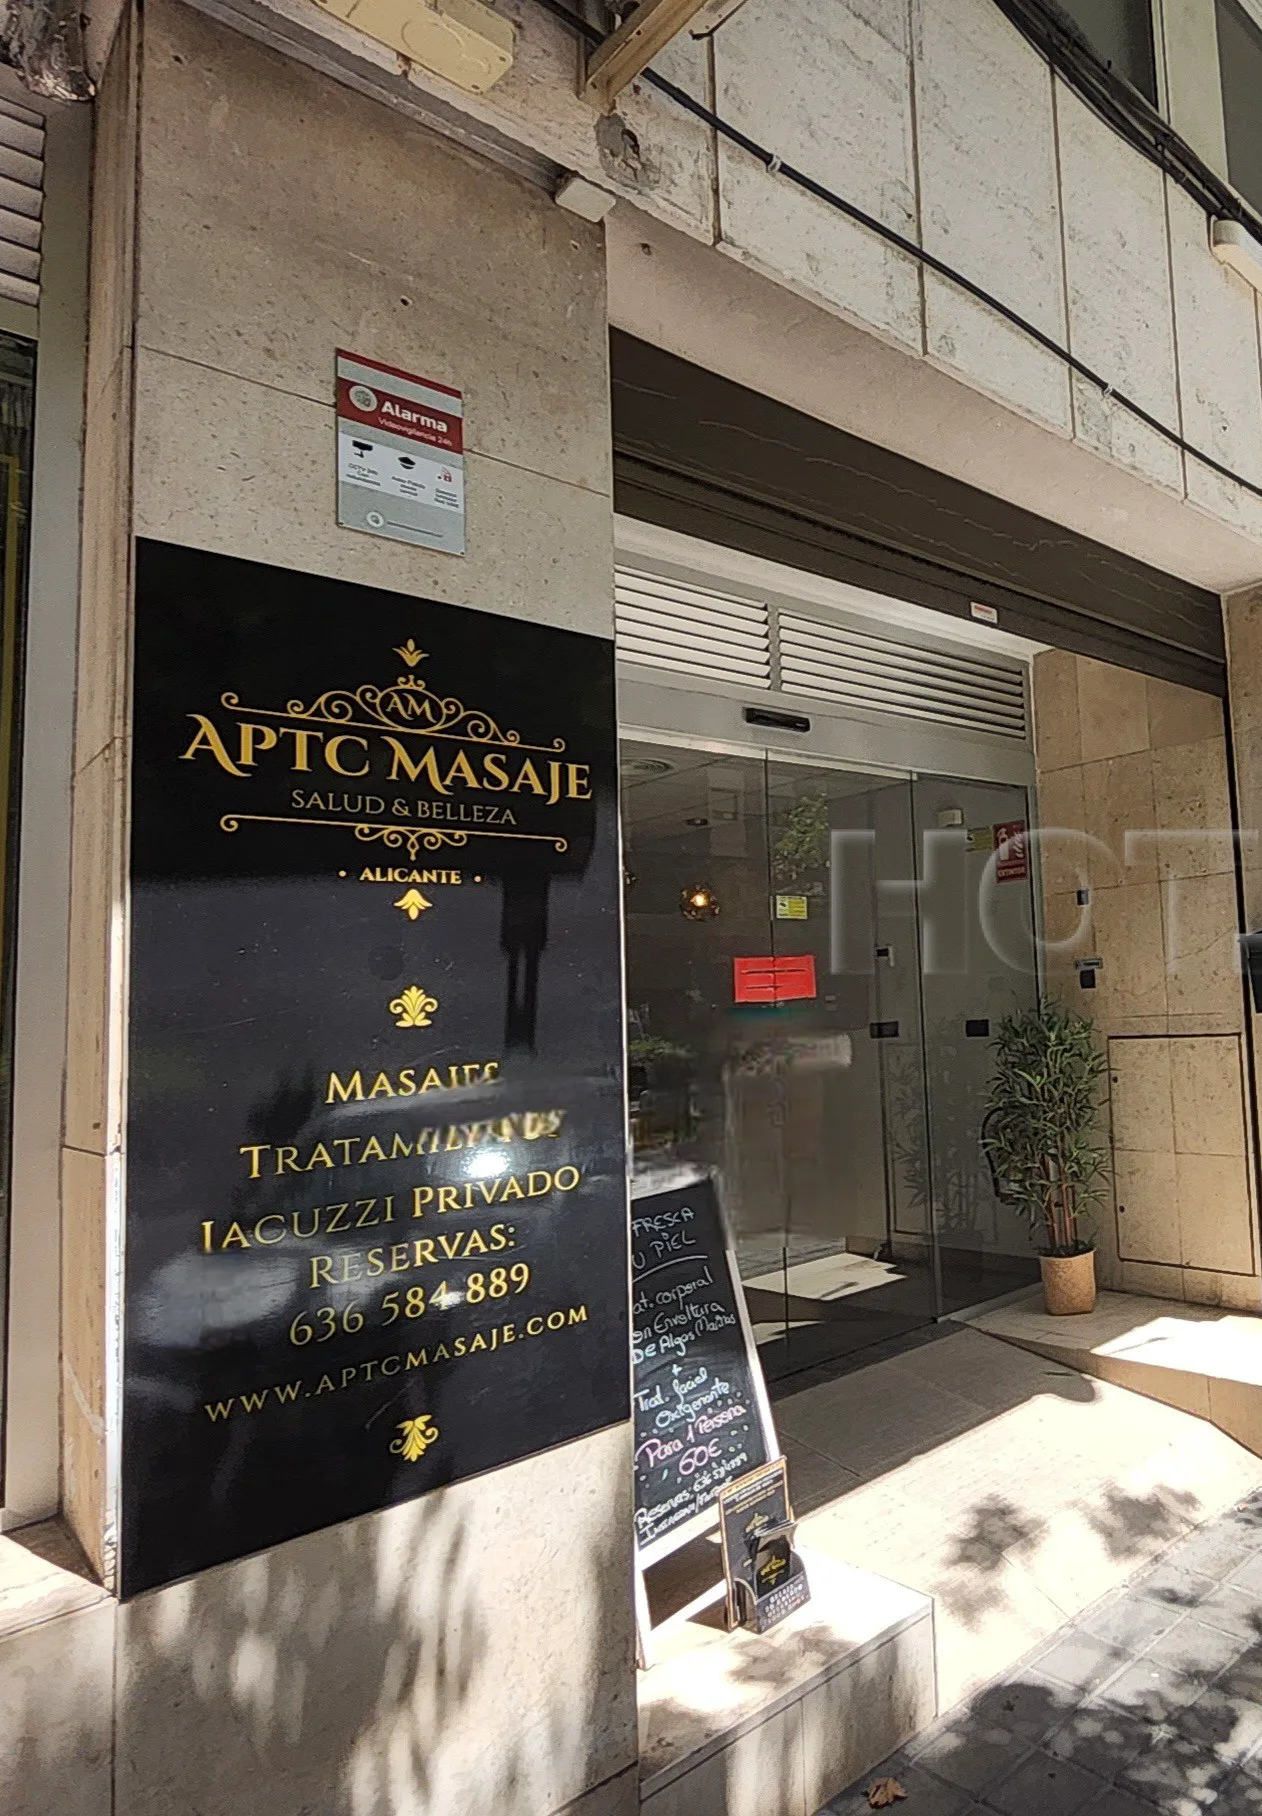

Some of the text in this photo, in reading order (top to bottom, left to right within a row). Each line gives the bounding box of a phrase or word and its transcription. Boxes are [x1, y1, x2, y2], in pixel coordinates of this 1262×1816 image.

[381, 401, 448, 433] Alarma
[385, 692, 437, 723] AM
[179, 714, 593, 805] APTC MASAJE
[291, 789, 517, 825] SALUD & BELLEZA
[359, 867, 462, 885] ALICANTE
[412, 1165, 580, 1218] PRIVADO
[309, 1224, 515, 1289] RESERVAS:
[632, 1251, 646, 1270] U
[289, 1263, 530, 1346] 636 584 889
[655, 1265, 713, 1311] corporal
[634, 1438, 684, 1468] Para
